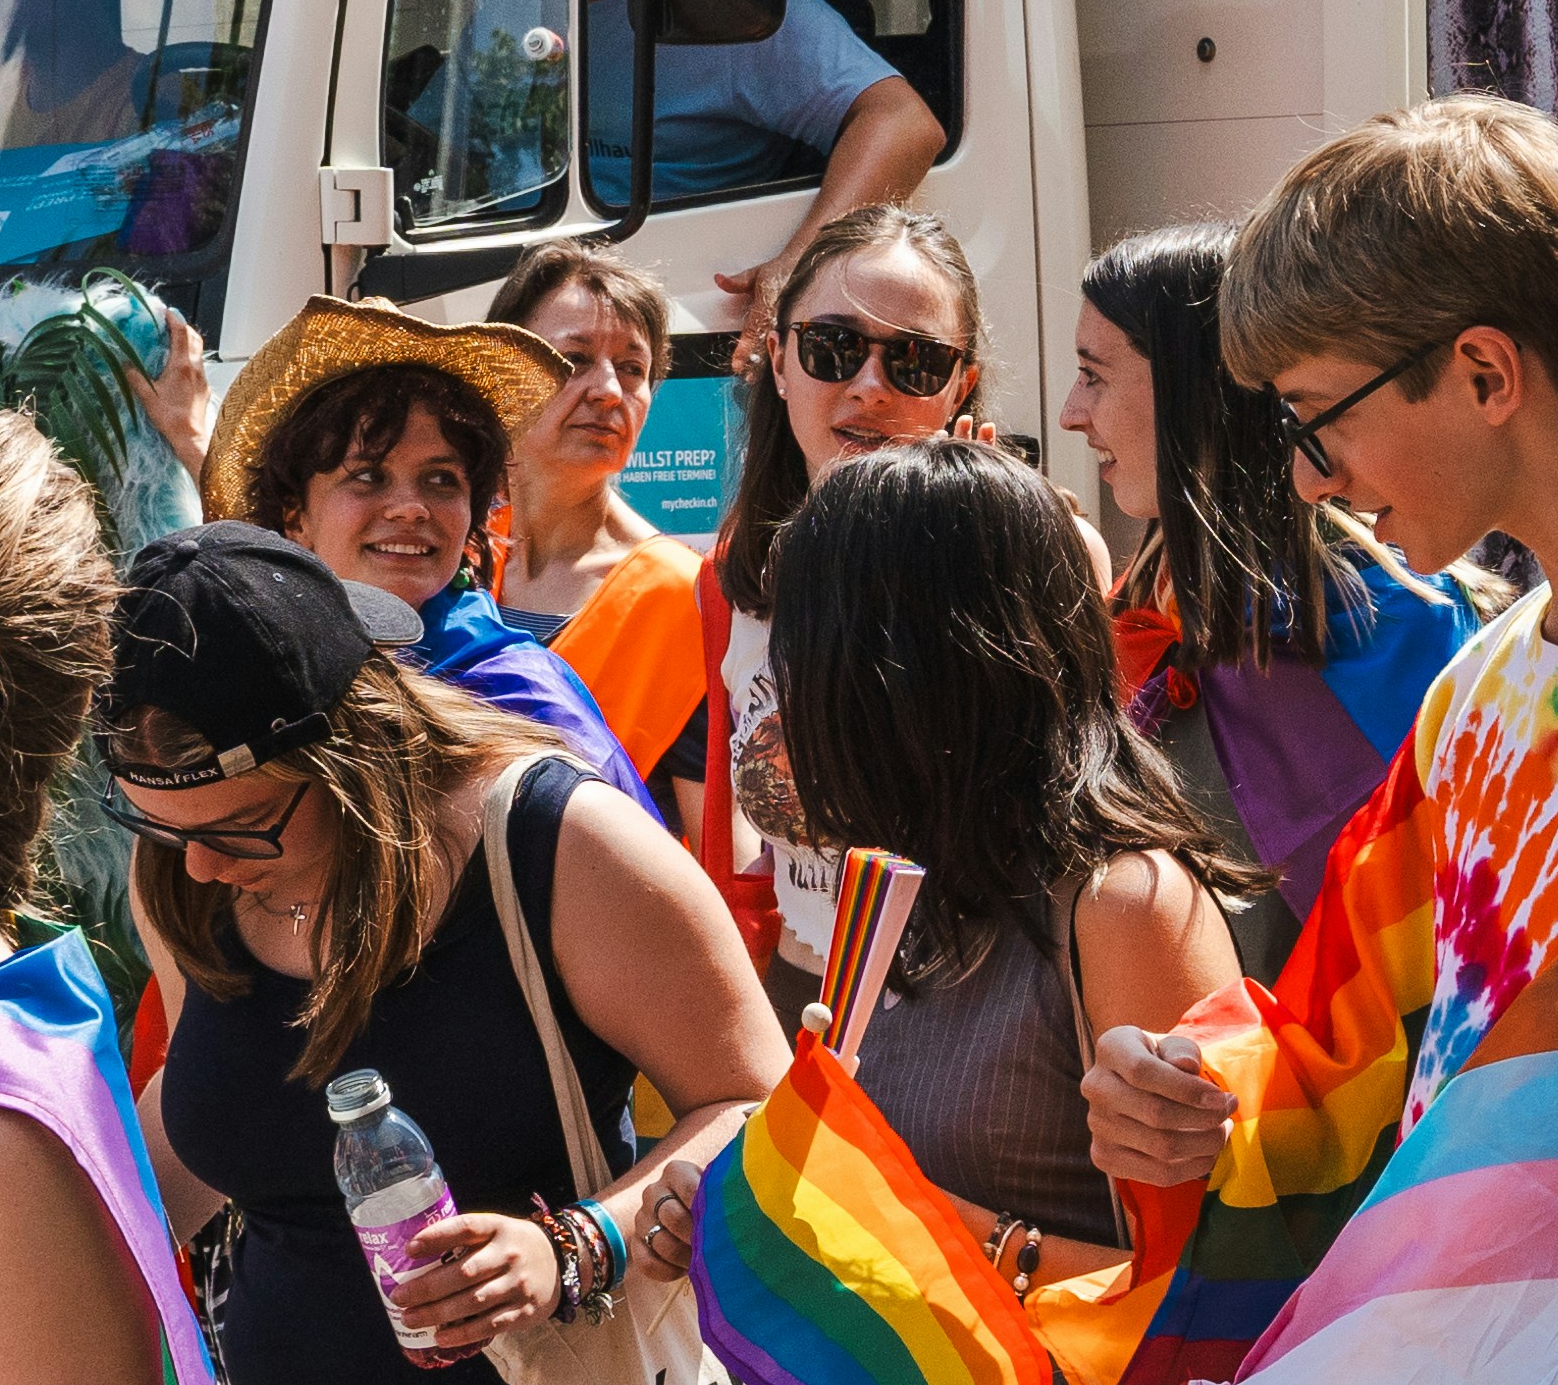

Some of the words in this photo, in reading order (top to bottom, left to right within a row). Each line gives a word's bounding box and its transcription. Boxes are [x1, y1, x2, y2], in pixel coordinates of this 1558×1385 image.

[626, 450, 673, 468] WILLST
[675, 449, 716, 467] PREP?
[623, 470, 652, 483] HABEN
[653, 470, 676, 482] FREIE
[678, 469, 716, 482] TERMINE!
[661, 496, 718, 513] mycheckin.ch
[357, 1231, 389, 1245] relax
